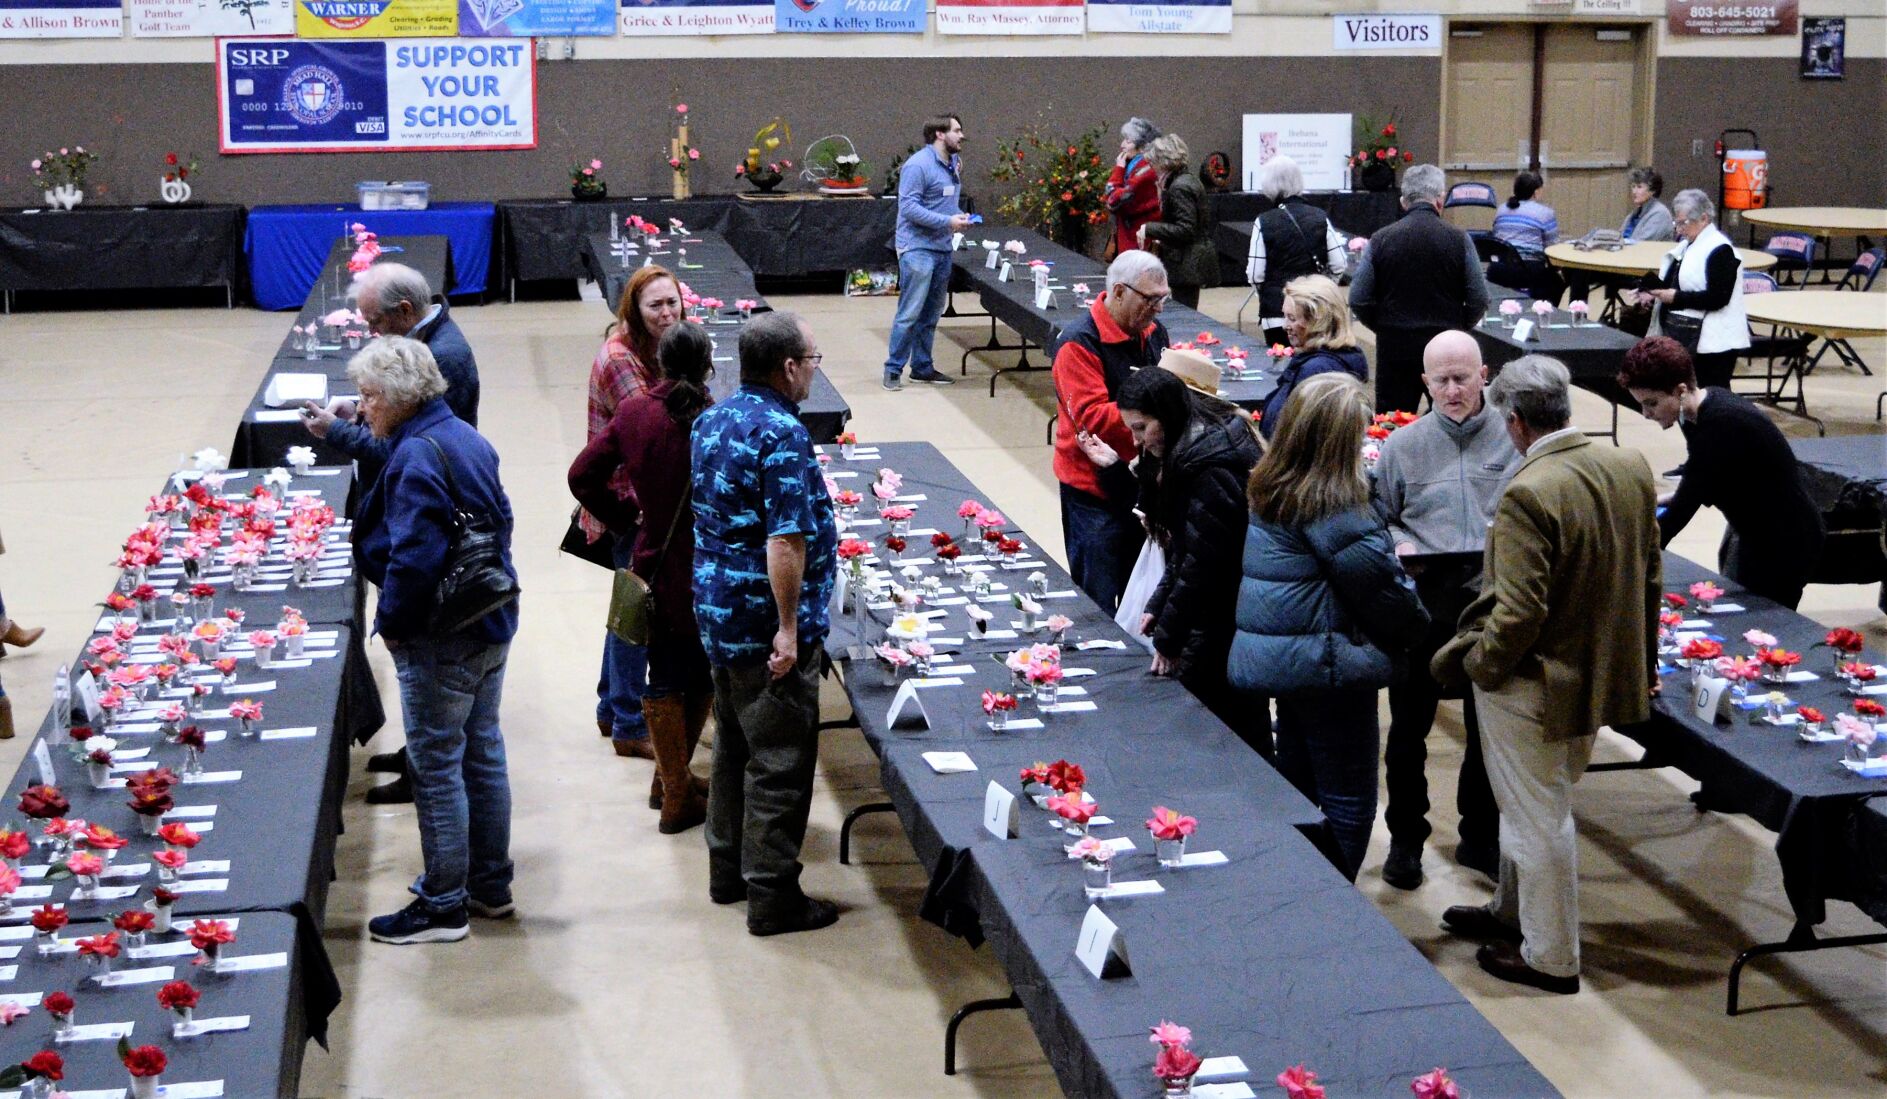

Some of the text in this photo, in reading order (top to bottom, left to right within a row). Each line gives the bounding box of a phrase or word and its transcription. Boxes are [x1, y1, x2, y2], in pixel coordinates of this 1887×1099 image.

[144, 9, 183, 18] Panther
[311, 2, 380, 15] WARNER
[1128, 6, 1193, 18] Tom Young
[1689, 6, 1776, 18] 803-645-5021
[2, 15, 119, 29] & Allison Brown
[139, 22, 191, 31] Golf Team
[389, 16, 418, 24] Clearing
[662, 15, 673, 26] &
[678, 14, 732, 27] Leighton
[737, 13, 774, 27] Wyatt
[785, 17, 812, 31] Trey
[818, 17, 828, 28] &
[875, 17, 915, 28] Brown
[967, 14, 987, 26] Ray
[1037, 14, 1080, 26] Attorney
[1139, 20, 1183, 31] Allstate
[1345, 18, 1429, 42] Visitors
[231, 49, 290, 66] SRP
[396, 45, 524, 68] SUPPORT
[293, 71, 314, 87] MEAD
[421, 75, 500, 97] YOUR
[403, 104, 517, 127] SCHOOL
[359, 123, 384, 132] VISA
[400, 128, 522, 140] www.srpfcu.org/AffinityCards
[1279, 140, 1328, 148] International
[1698, 688, 1709, 708] D
[992, 799, 1000, 822] J
